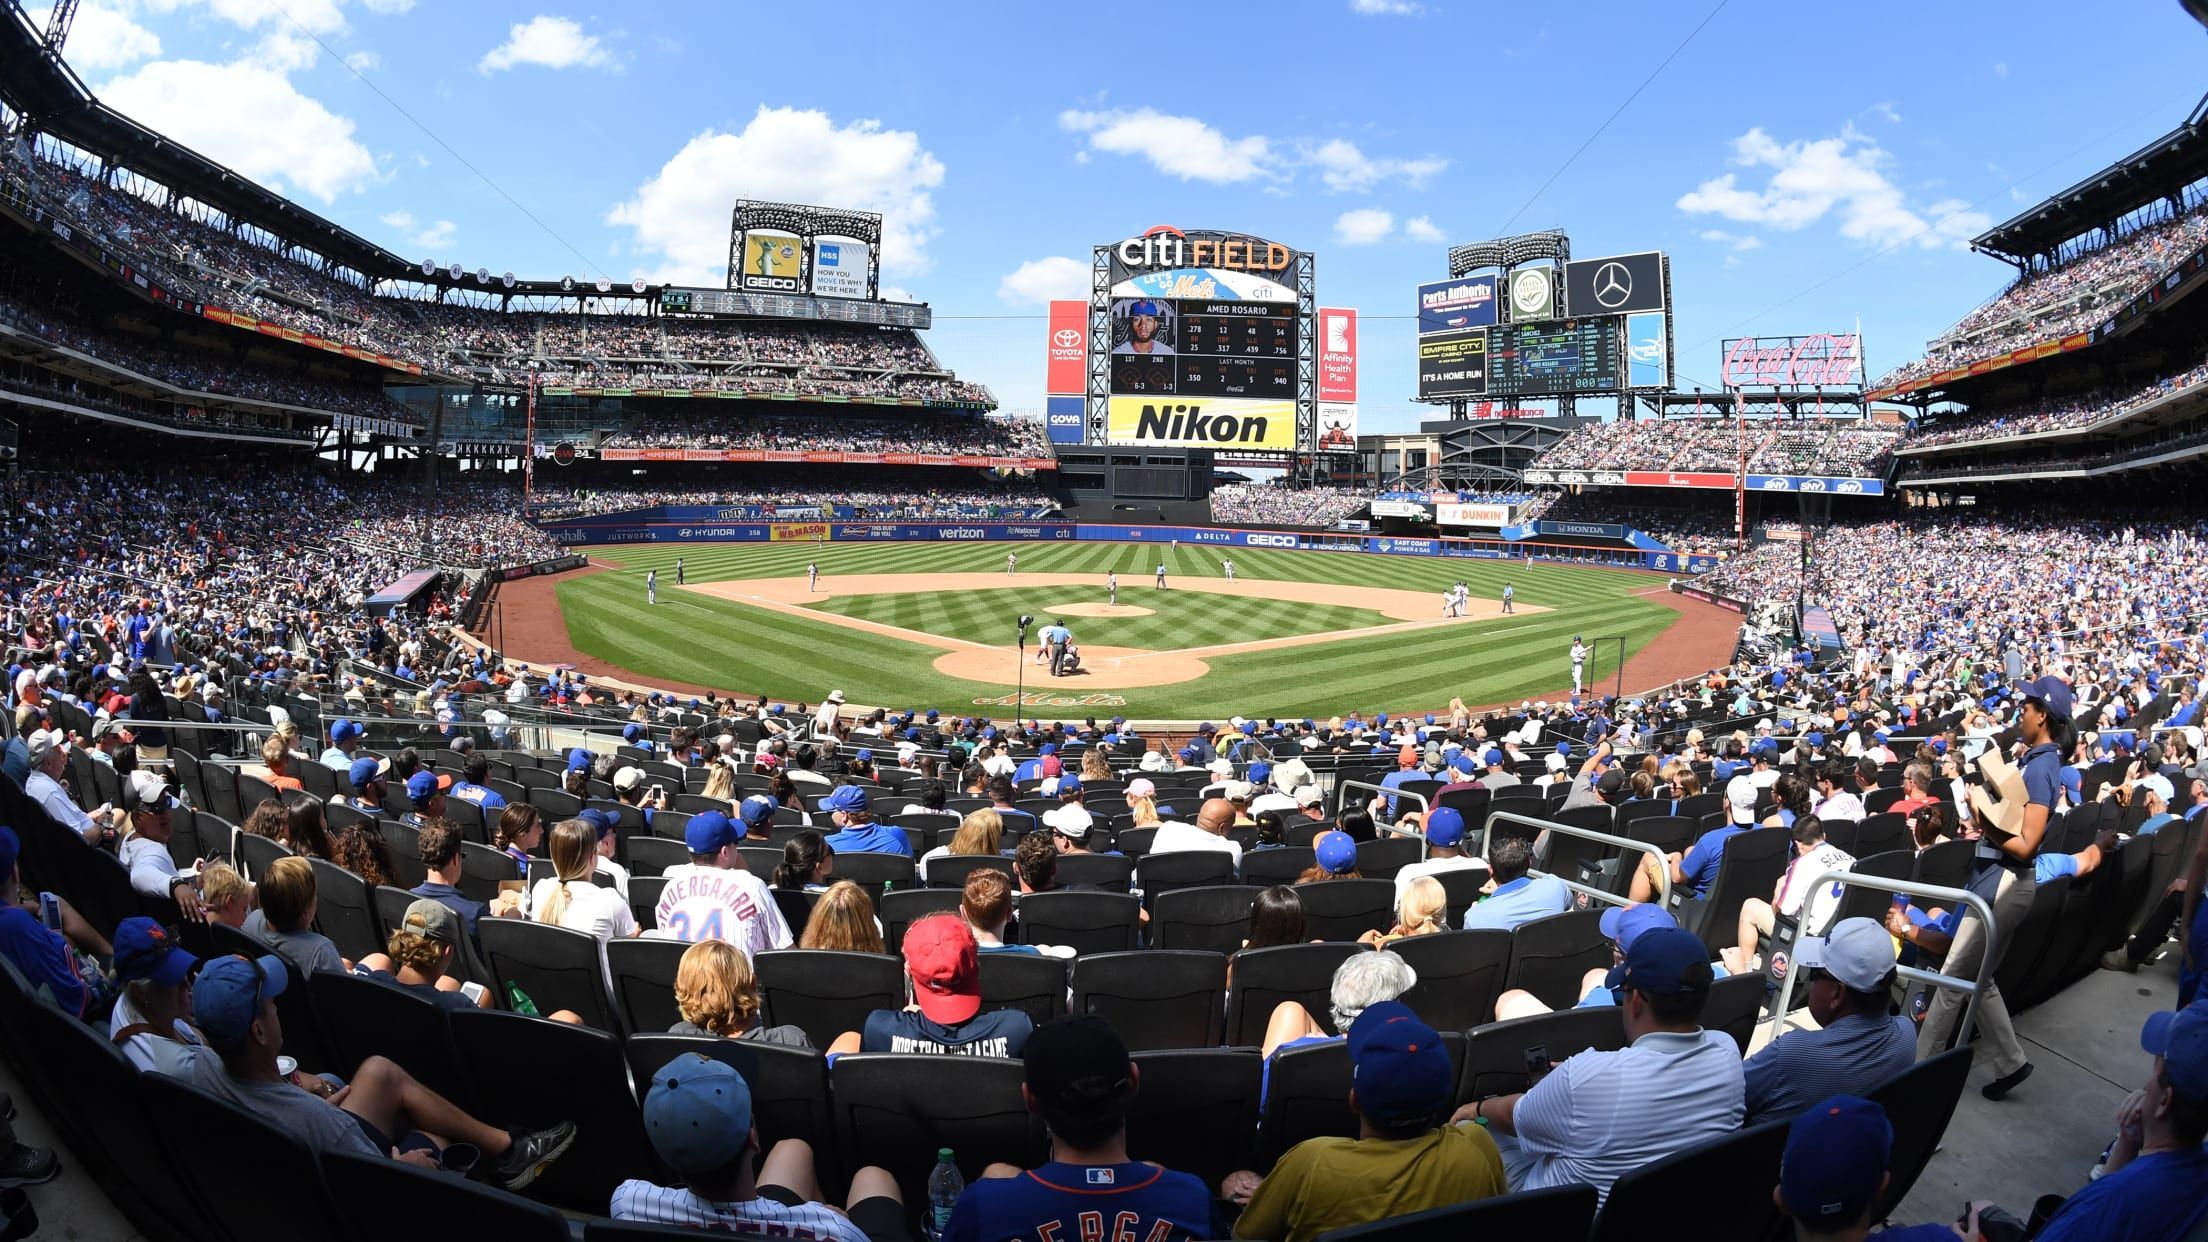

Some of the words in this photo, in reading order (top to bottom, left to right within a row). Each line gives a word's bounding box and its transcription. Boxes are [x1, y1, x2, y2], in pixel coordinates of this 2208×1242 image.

[821, 251, 837, 259] HSS
[1120, 230, 1182, 266] citi
[1193, 240, 1290, 270] FIELD
[746, 277, 795, 289] GEICO
[1144, 274, 1172, 284] LET'S
[1160, 280, 1173, 289] GO
[1166, 276, 1217, 298] Mets
[1423, 290, 1446, 304] Parts
[1448, 284, 1491, 300] Authority
[1207, 305, 1229, 313] AMED
[1232, 306, 1267, 315] ROSARIO
[1424, 345, 1457, 354] EMPIRE
[1323, 353, 1353, 364] Affinity
[1325, 364, 1351, 373] Health
[1330, 373, 1346, 382] Plan
[1443, 372, 1465, 380] HOME
[1466, 370, 1482, 378] RUN
[482, 386, 530, 394] PORSCH
[1050, 415, 1080, 424] GOYA
[1136, 404, 1268, 442] Nikon
[1764, 480, 1785, 490] SNY
[1800, 482, 1820, 491] SNY
[1837, 483, 1858, 492] SNY
[1462, 510, 1504, 520] DUNKIN'
[779, 525, 826, 538] W.B.MASON
[939, 527, 984, 539] verizon
[1056, 529, 1070, 538] citi
[1204, 533, 1230, 541] DELTA
[1247, 534, 1296, 547] GEICO
[669, 908, 726, 943] 34
[891, 1036, 917, 1053] MORE
[919, 1041, 945, 1054] THAN
[975, 1043, 980, 1056] A
[982, 1037, 1009, 1058] GAME
